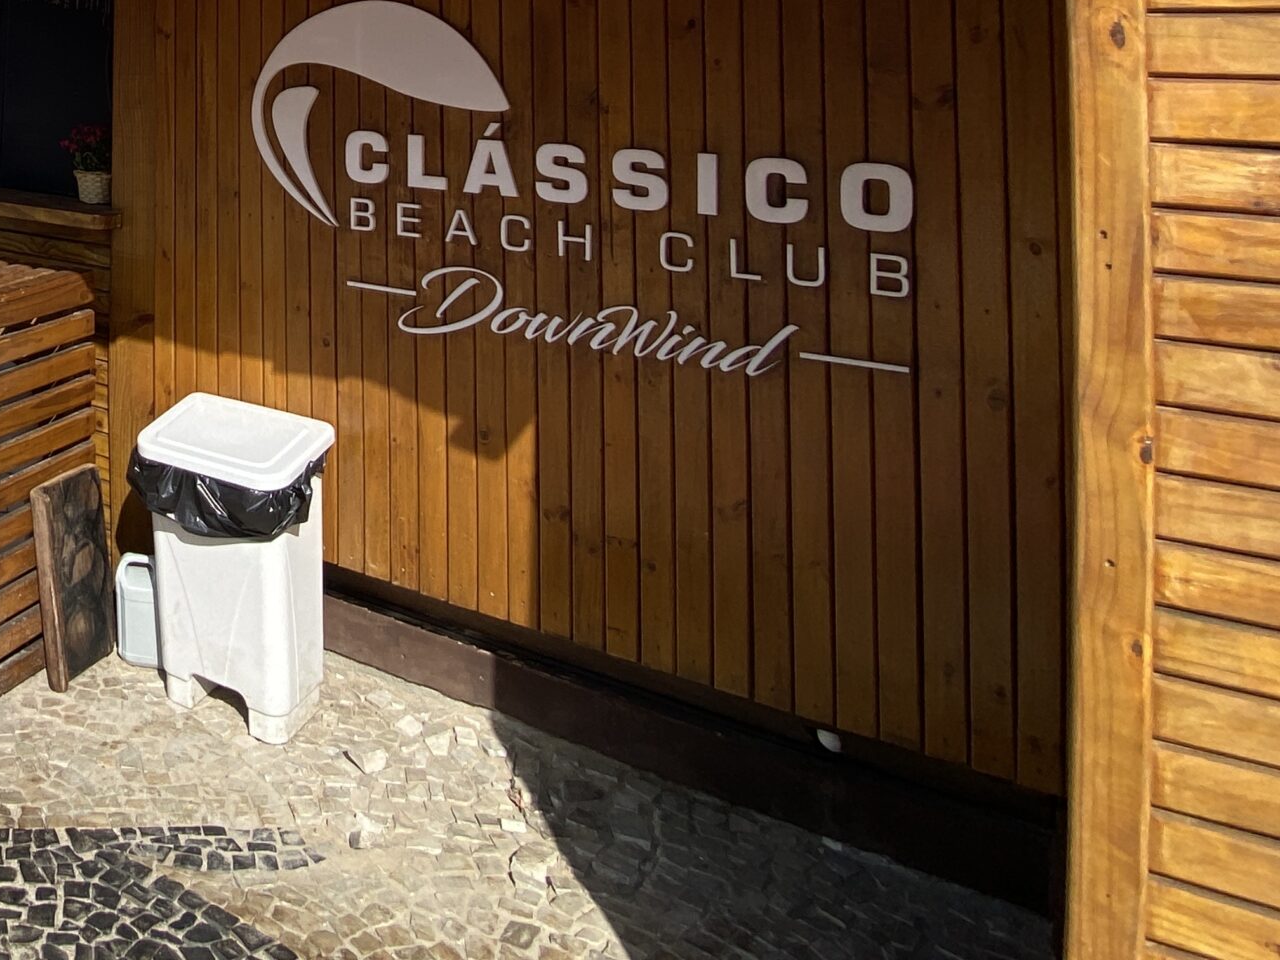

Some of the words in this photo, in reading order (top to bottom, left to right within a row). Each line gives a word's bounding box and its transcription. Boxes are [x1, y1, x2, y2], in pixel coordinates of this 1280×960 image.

[345, 122, 913, 232] CLÁSSICO
[349, 198, 593, 262] BEACH
[659, 231, 910, 298] CLUB
[398, 266, 799, 377] DownWind
